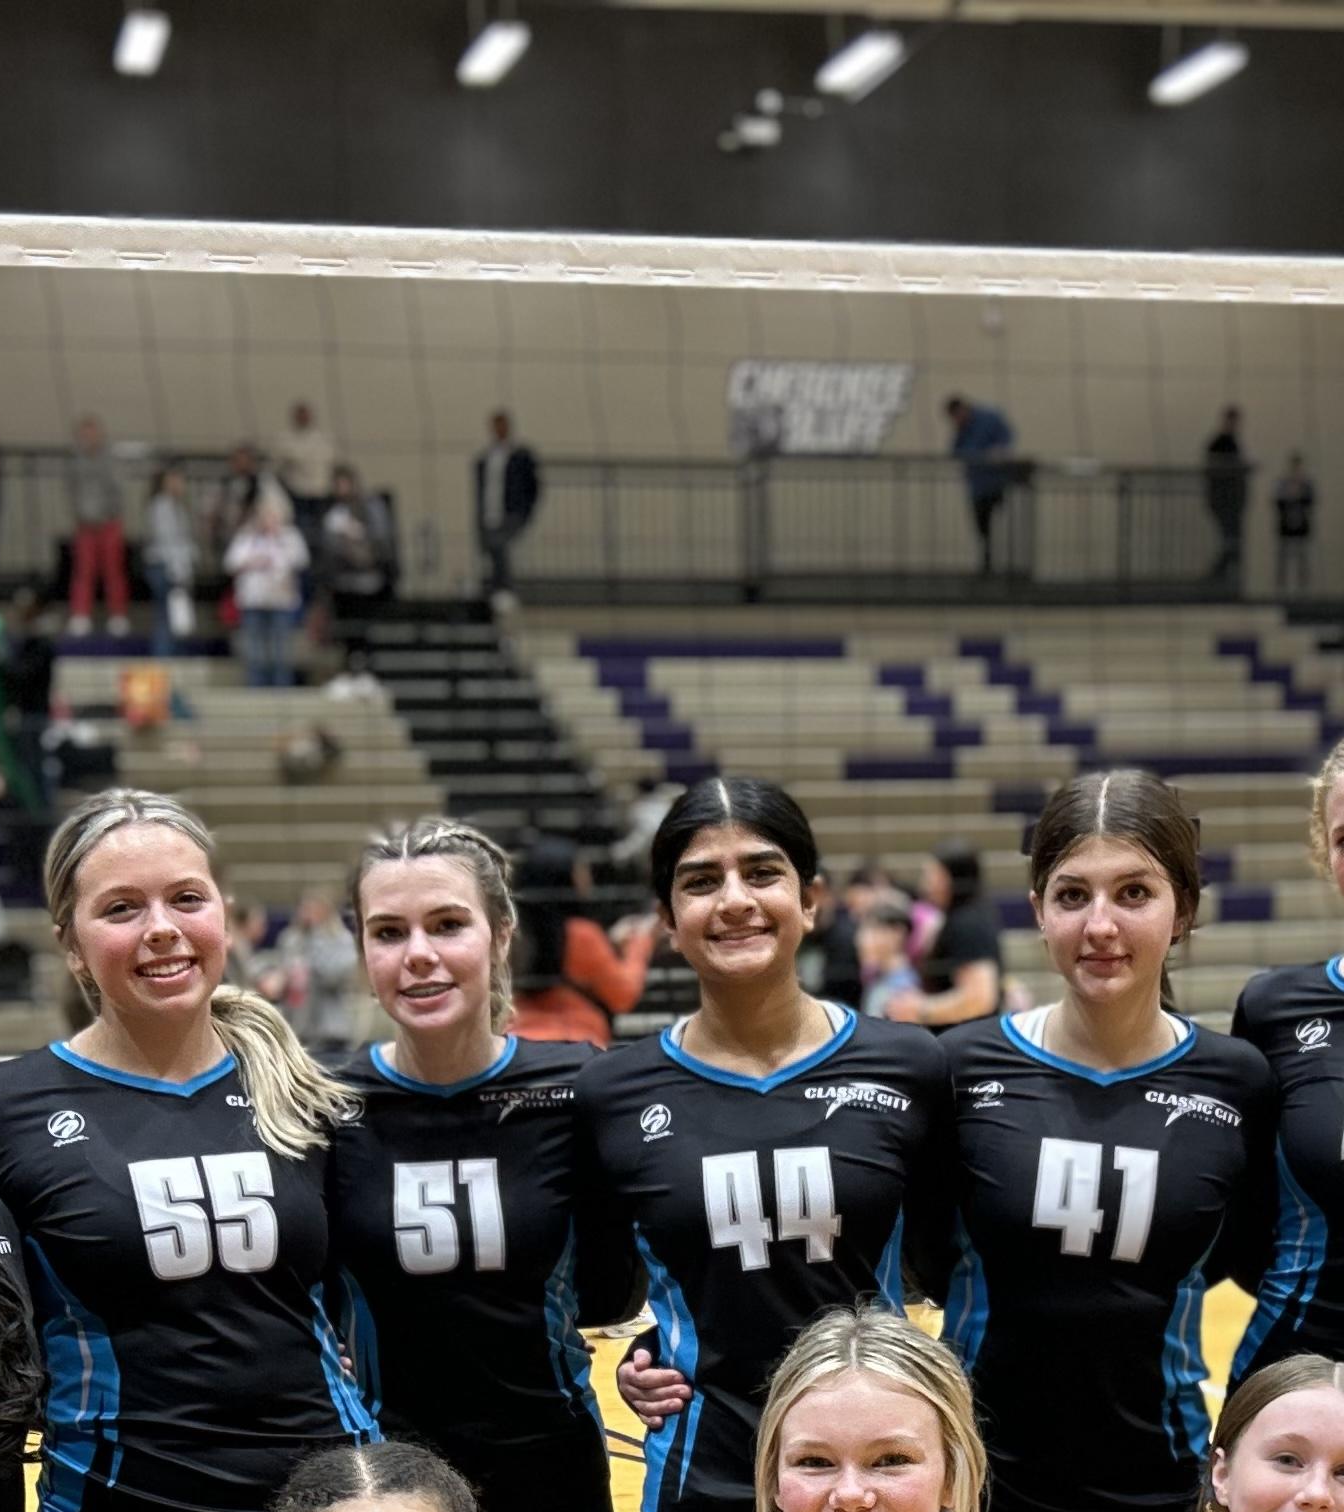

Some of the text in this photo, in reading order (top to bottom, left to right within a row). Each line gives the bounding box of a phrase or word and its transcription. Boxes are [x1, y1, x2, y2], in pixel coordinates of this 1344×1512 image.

[804, 1086, 912, 1112] CLASSIC CITY
[1145, 1090, 1214, 1115] CLASSIC
[1214, 1107, 1242, 1127] CITY
[128, 1151, 279, 1281] 55
[393, 1157, 506, 1275] 51
[702, 1146, 842, 1271] 44
[1032, 1137, 1159, 1263] 41
